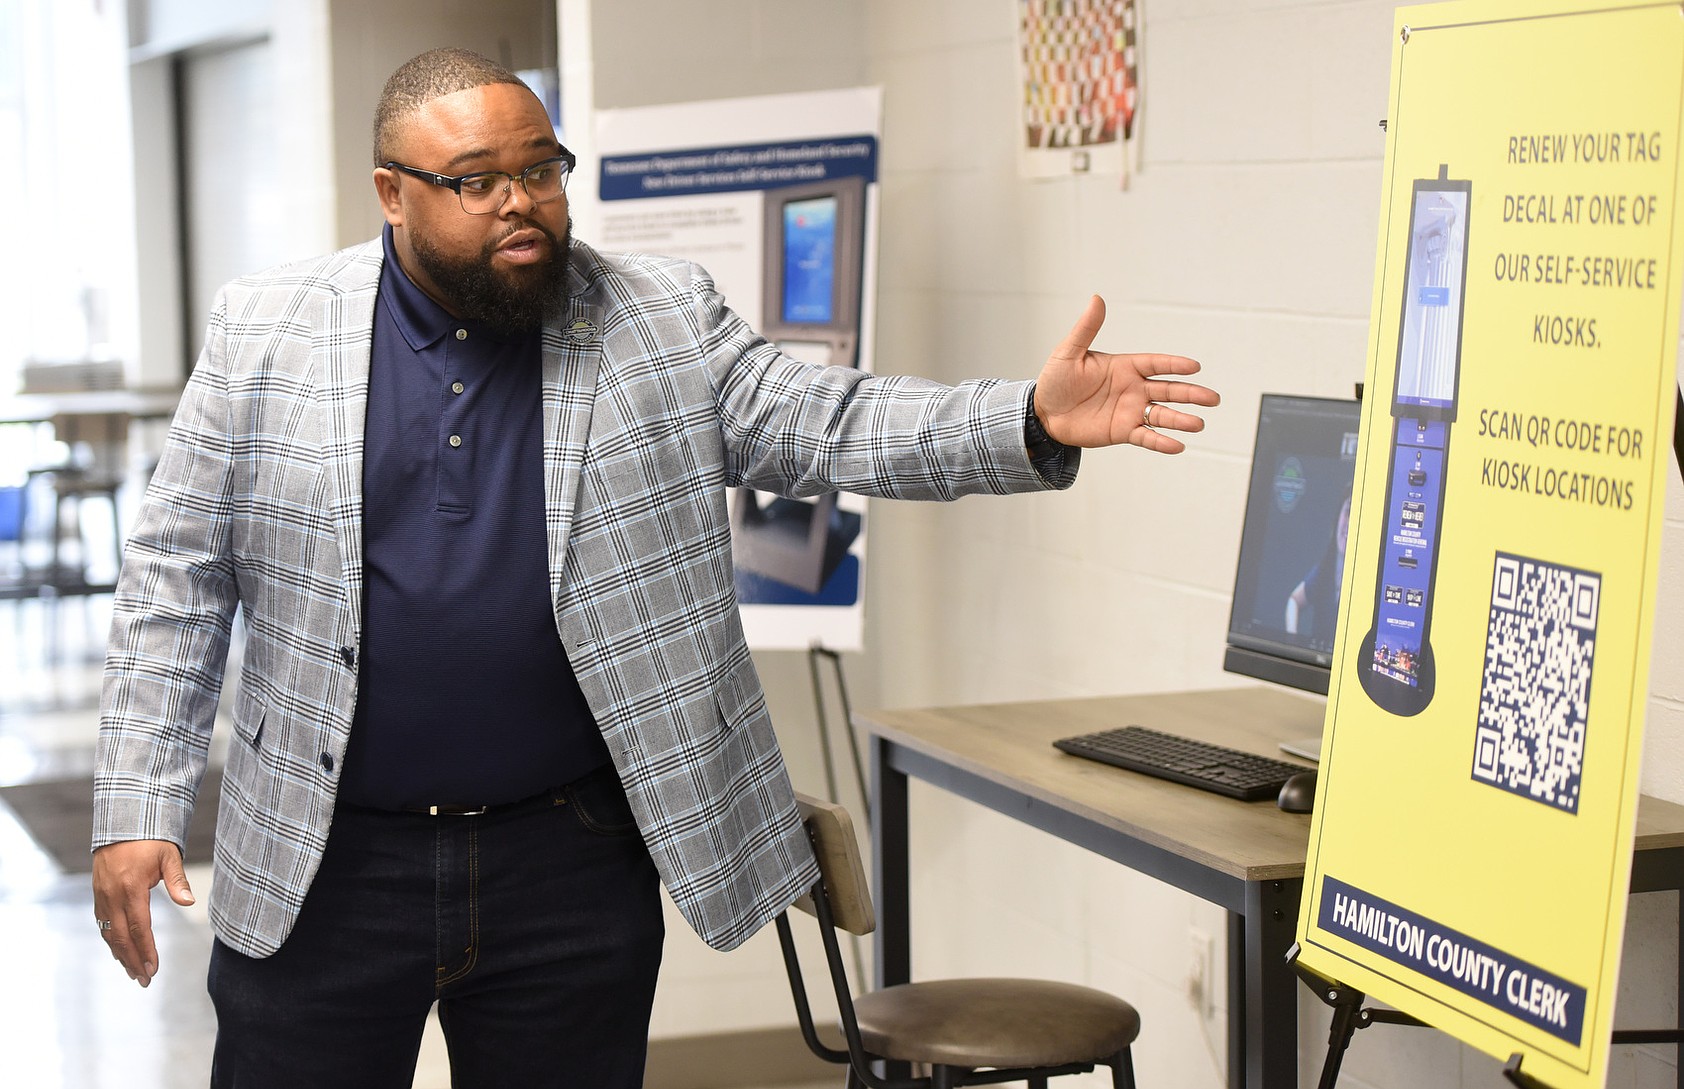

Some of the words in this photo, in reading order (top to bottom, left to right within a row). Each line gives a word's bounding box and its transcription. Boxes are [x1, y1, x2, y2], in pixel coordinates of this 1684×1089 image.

[1508, 134, 1568, 164] RENEW
[1572, 132, 1621, 163] YOUR
[1626, 131, 1661, 162] TAG
[1503, 195, 1557, 223] DECAL
[1562, 195, 1584, 224] AT
[1589, 195, 1627, 225] ONE
[1632, 195, 1657, 226] OF
[1494, 253, 1530, 282] OUR
[1534, 254, 1657, 289] SELF-SERVICE
[1533, 314, 1601, 348] KIOSKS.
[1478, 408, 1523, 441] SCAN
[1527, 415, 1551, 448] QR
[1555, 419, 1602, 453] CODE
[1606, 425, 1643, 459] FOR
[1481, 457, 1531, 493] KIOSK
[1535, 466, 1634, 511] LOCATIONS
[1332, 893, 1425, 960] HAMILTON
[1427, 934, 1506, 995] COUNTY
[1507, 969, 1570, 1028] CLERK
